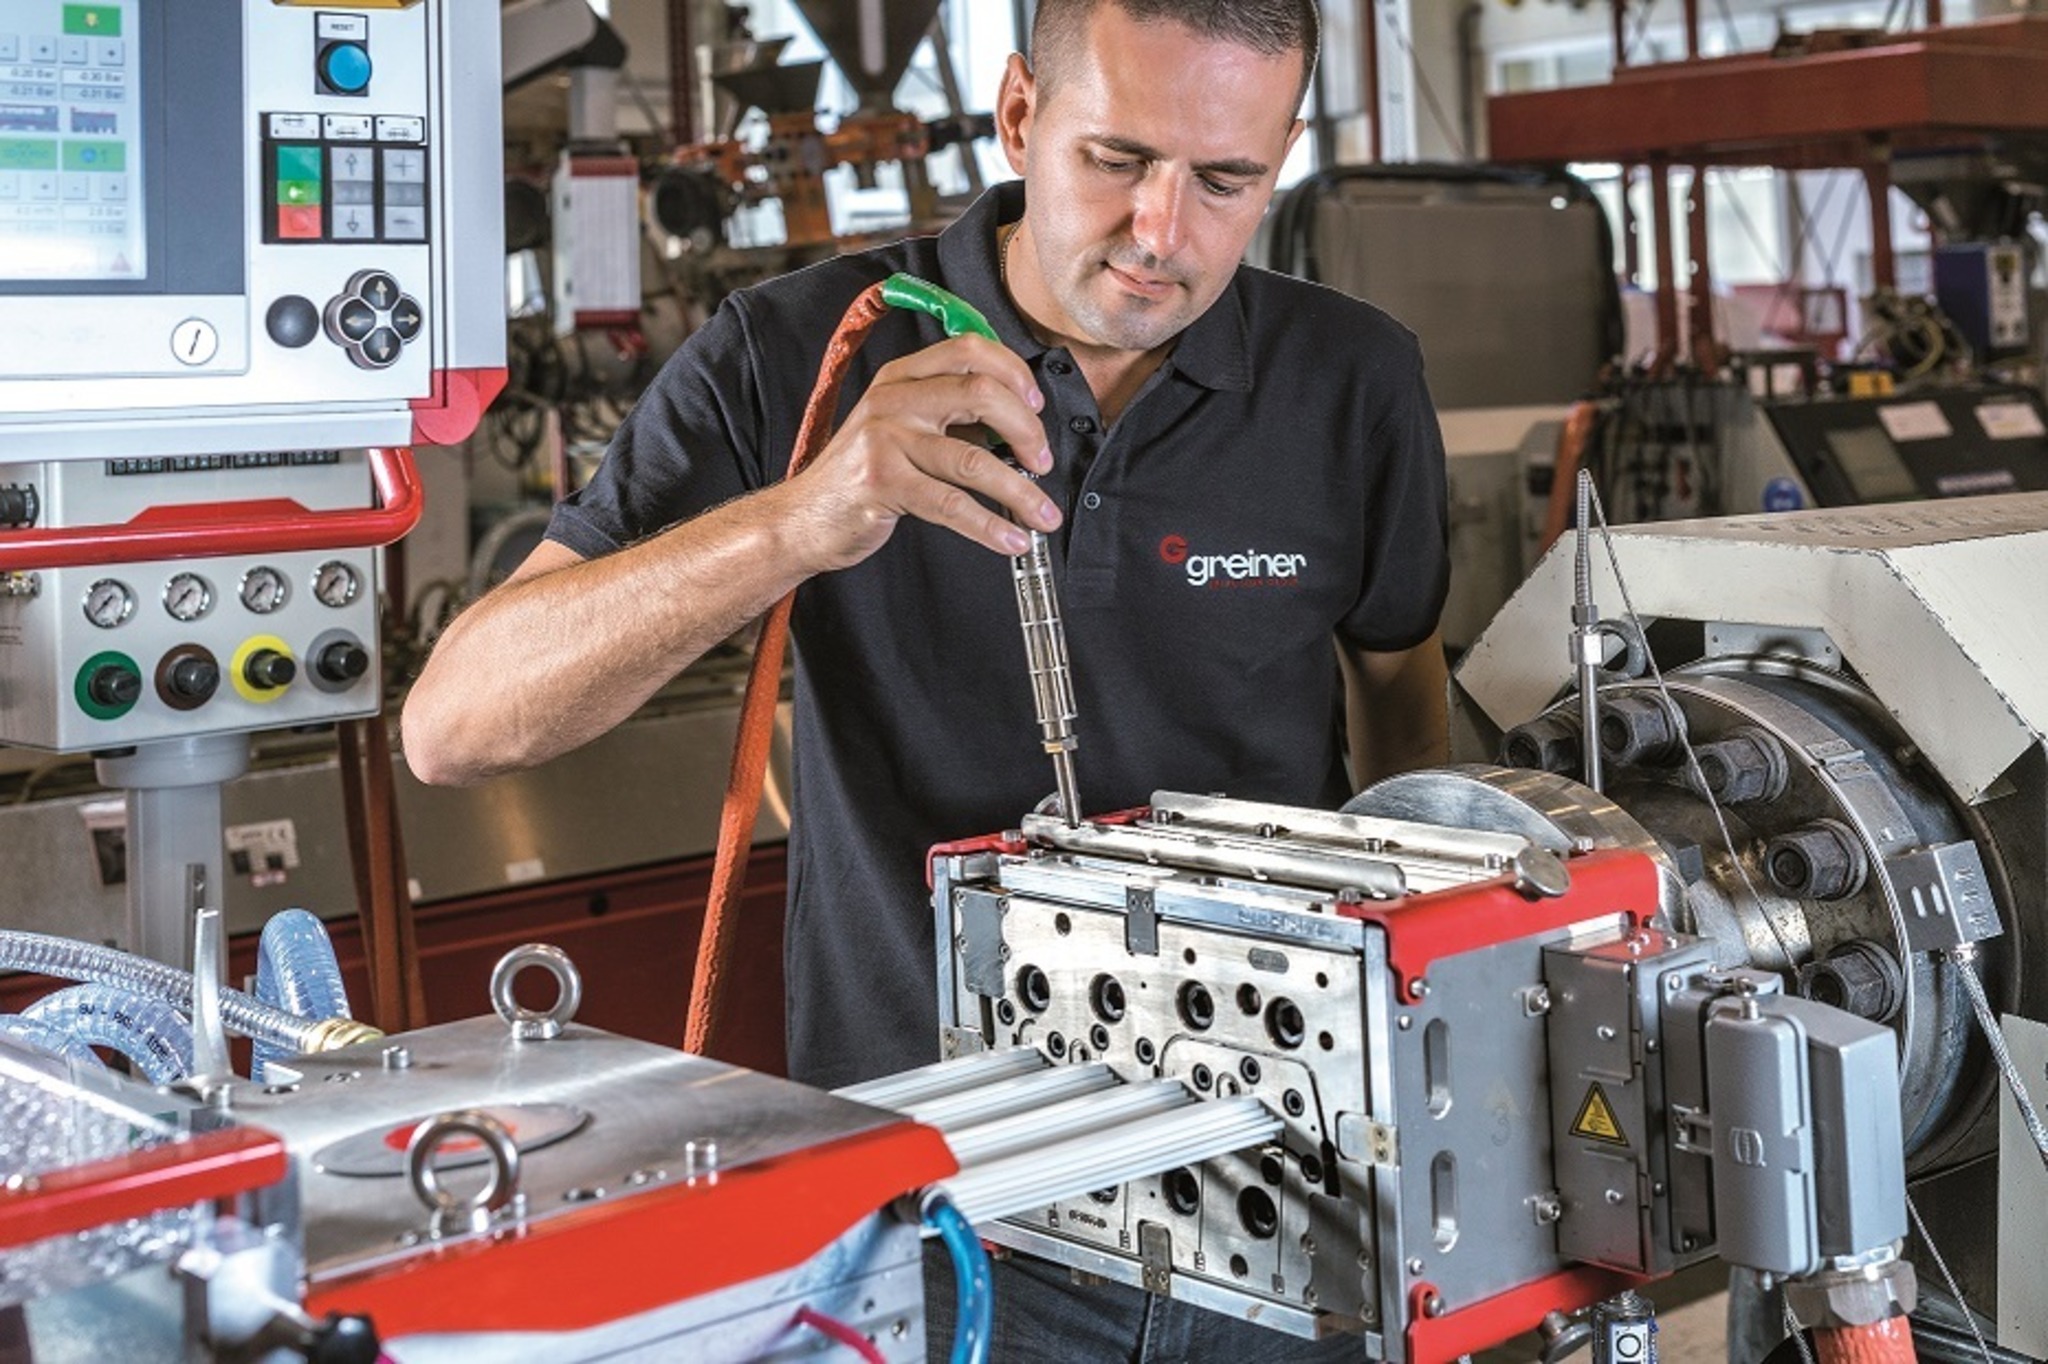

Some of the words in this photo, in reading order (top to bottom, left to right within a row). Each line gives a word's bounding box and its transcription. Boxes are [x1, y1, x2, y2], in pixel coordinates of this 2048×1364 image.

[330, 23, 355, 32] RESET
[104, 72, 122, 82] Bar
[104, 89, 123, 100] Bar
[1185, 548, 1307, 587] greiner
